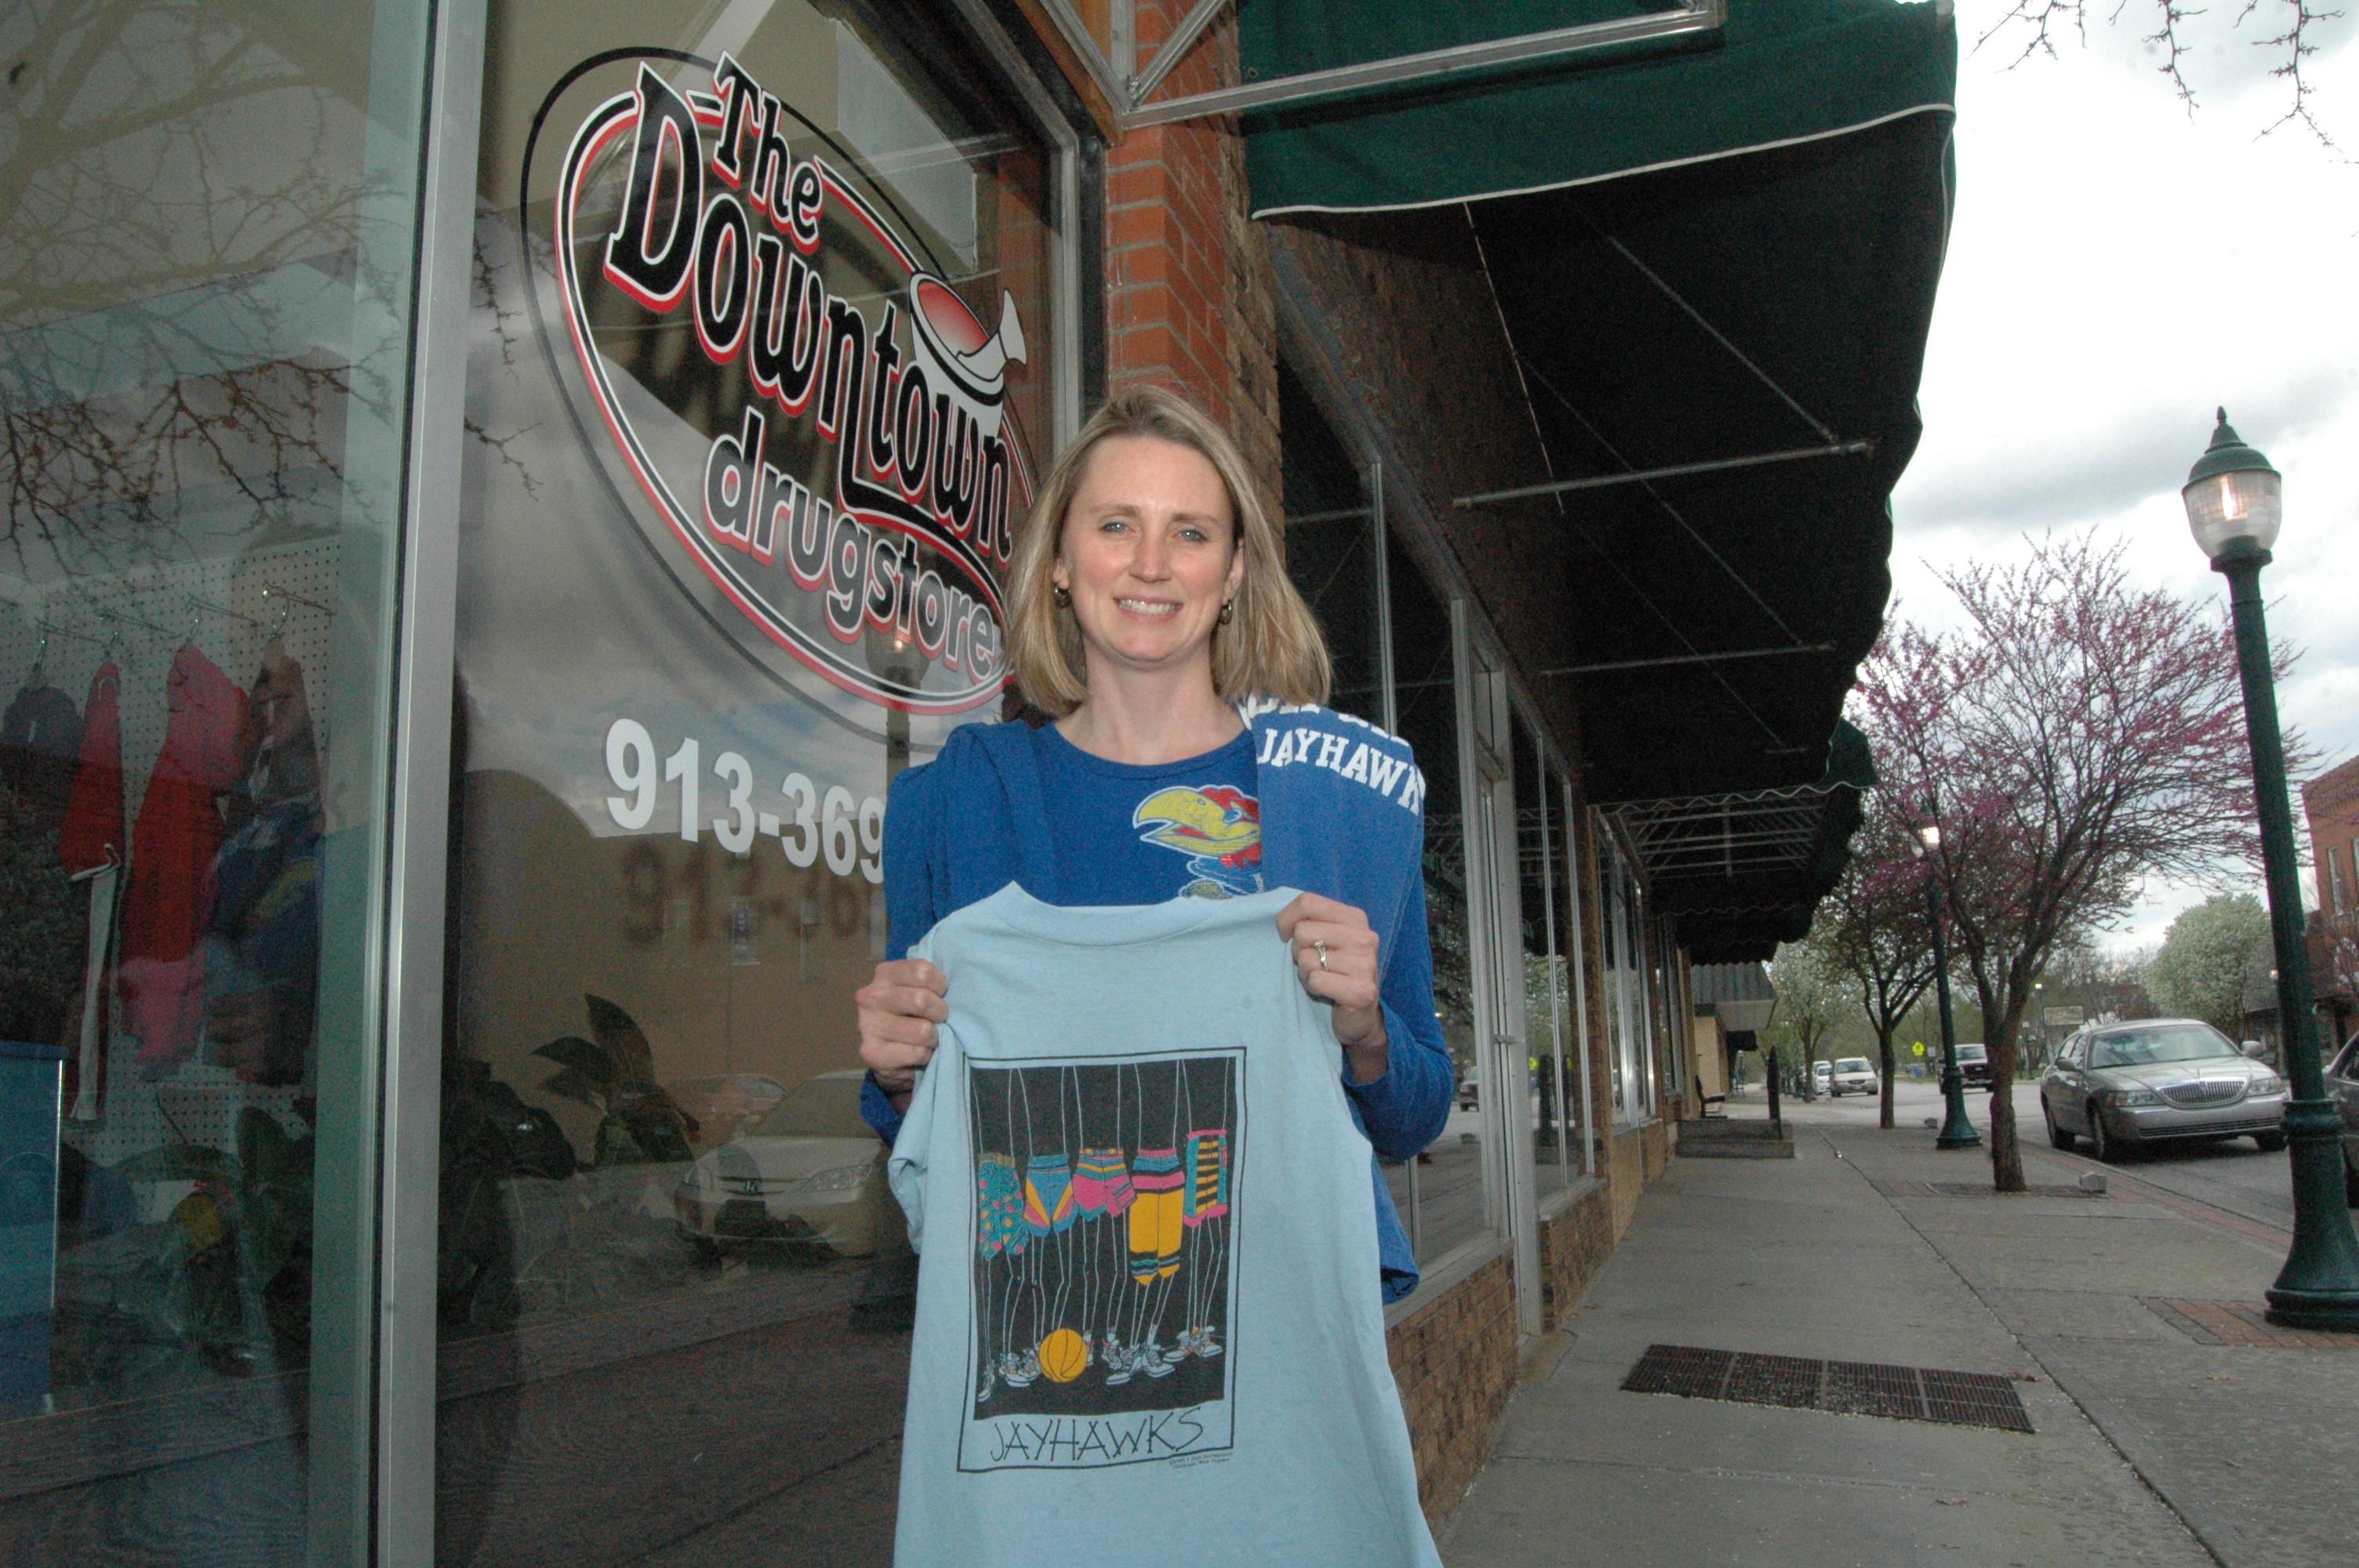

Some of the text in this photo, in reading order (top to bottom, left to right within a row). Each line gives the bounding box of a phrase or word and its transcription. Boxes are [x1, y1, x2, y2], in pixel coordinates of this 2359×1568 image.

[714, 50, 823, 252] The
[603, 61, 1013, 569] Downtown
[705, 405, 997, 684] drugstore
[605, 718, 884, 884] 913-369
[990, 1406, 1203, 1462] JAYHAWKS
